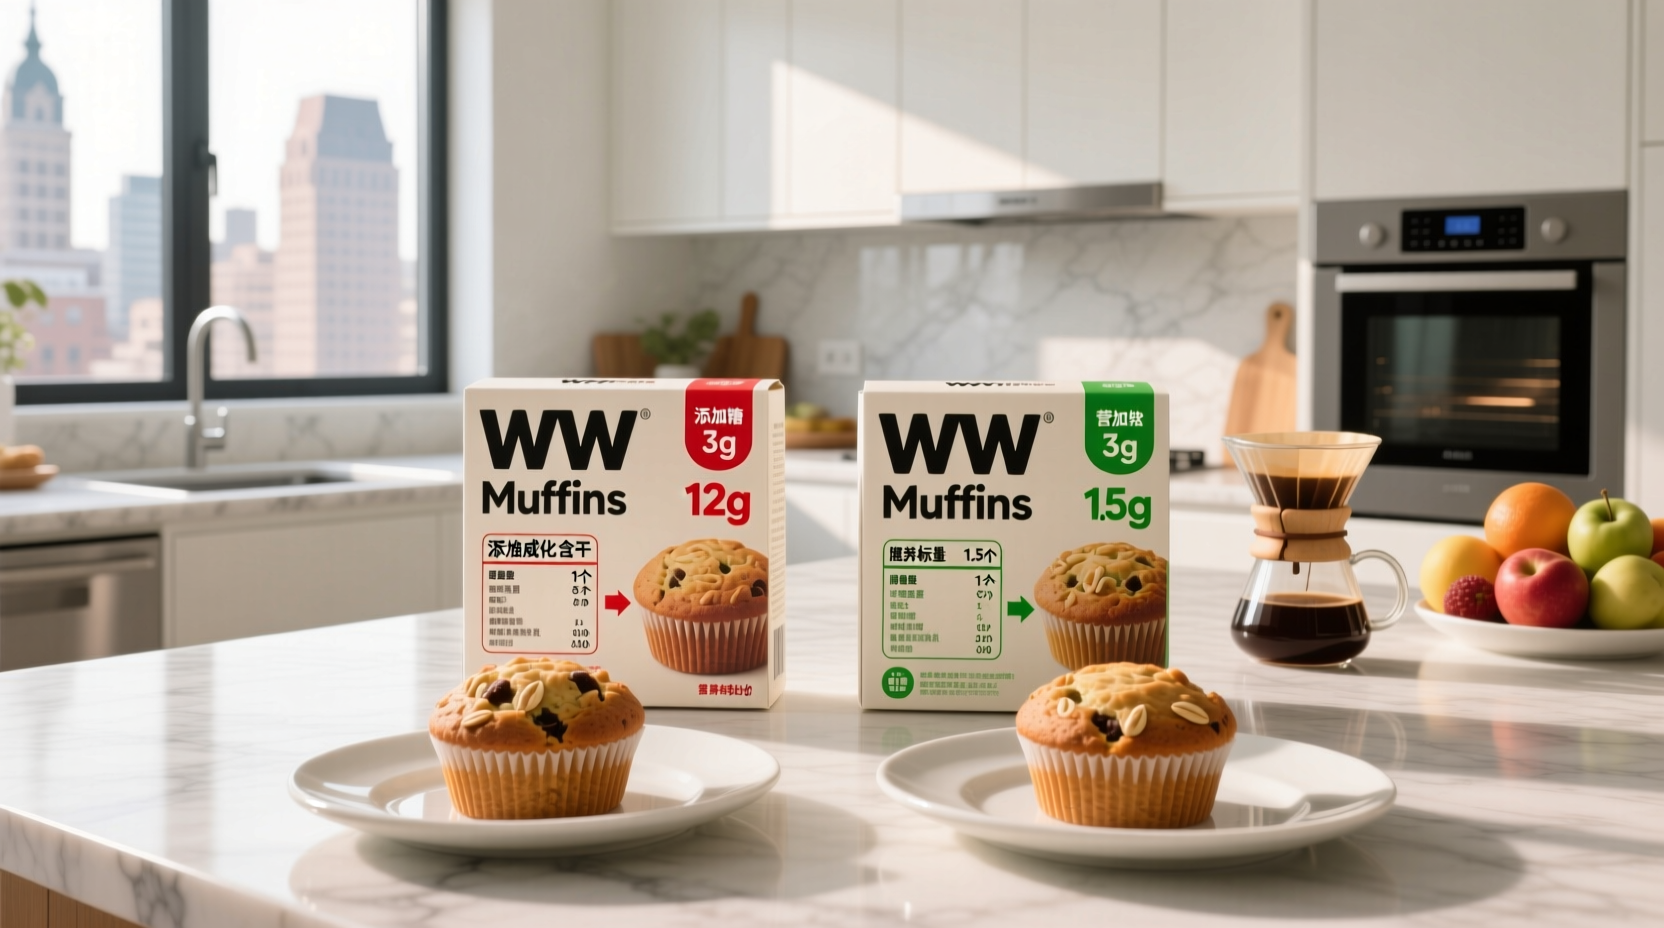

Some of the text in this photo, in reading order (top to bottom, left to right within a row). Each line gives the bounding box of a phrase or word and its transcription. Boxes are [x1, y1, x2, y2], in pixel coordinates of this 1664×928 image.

[479, 409, 638, 471] WW
[702, 429, 736, 460] 3g
[878, 413, 1041, 475] WW
[1102, 432, 1138, 465] 3g
[482, 479, 627, 515] Muffins
[685, 482, 751, 526] 12g
[883, 484, 1033, 520] Muffins
[1084, 487, 1152, 530] 1.5g
